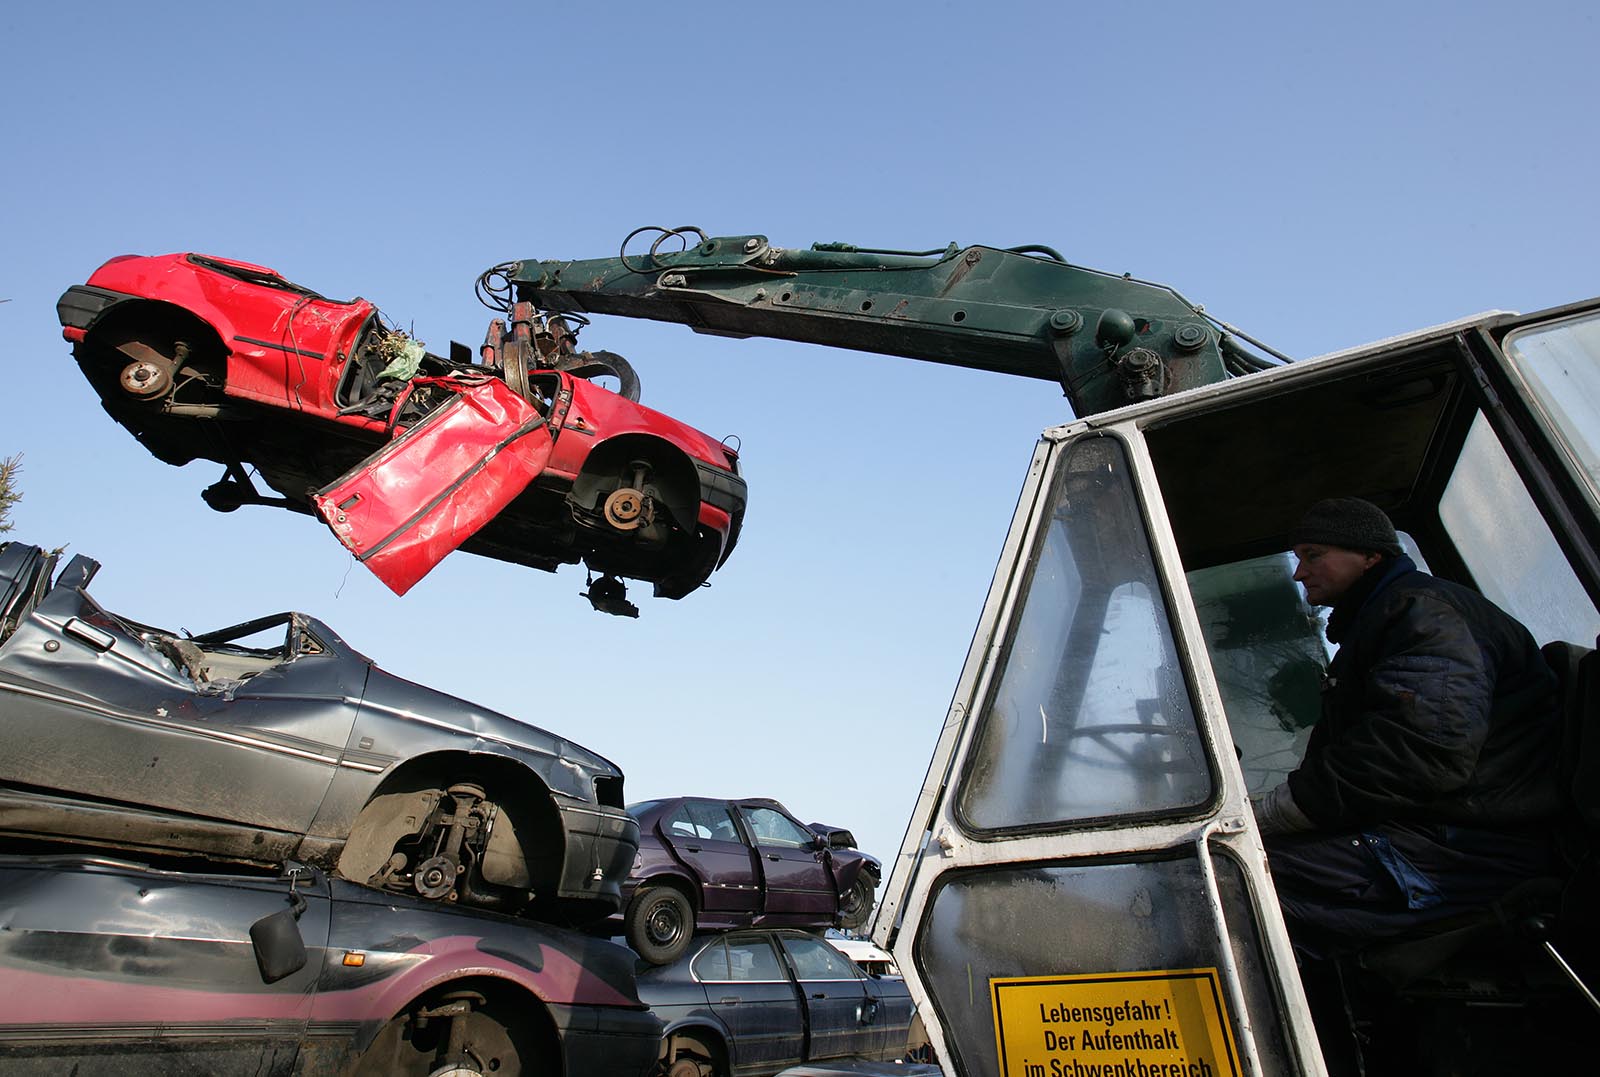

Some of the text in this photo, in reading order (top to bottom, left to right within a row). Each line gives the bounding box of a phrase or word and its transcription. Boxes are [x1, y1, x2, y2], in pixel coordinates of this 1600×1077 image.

[1040, 999, 1172, 1026] Lebensgefahr!
[1044, 1028, 1179, 1051] Der Aufenthalt
[1024, 1057, 1212, 1077] im Schwenkbereich
